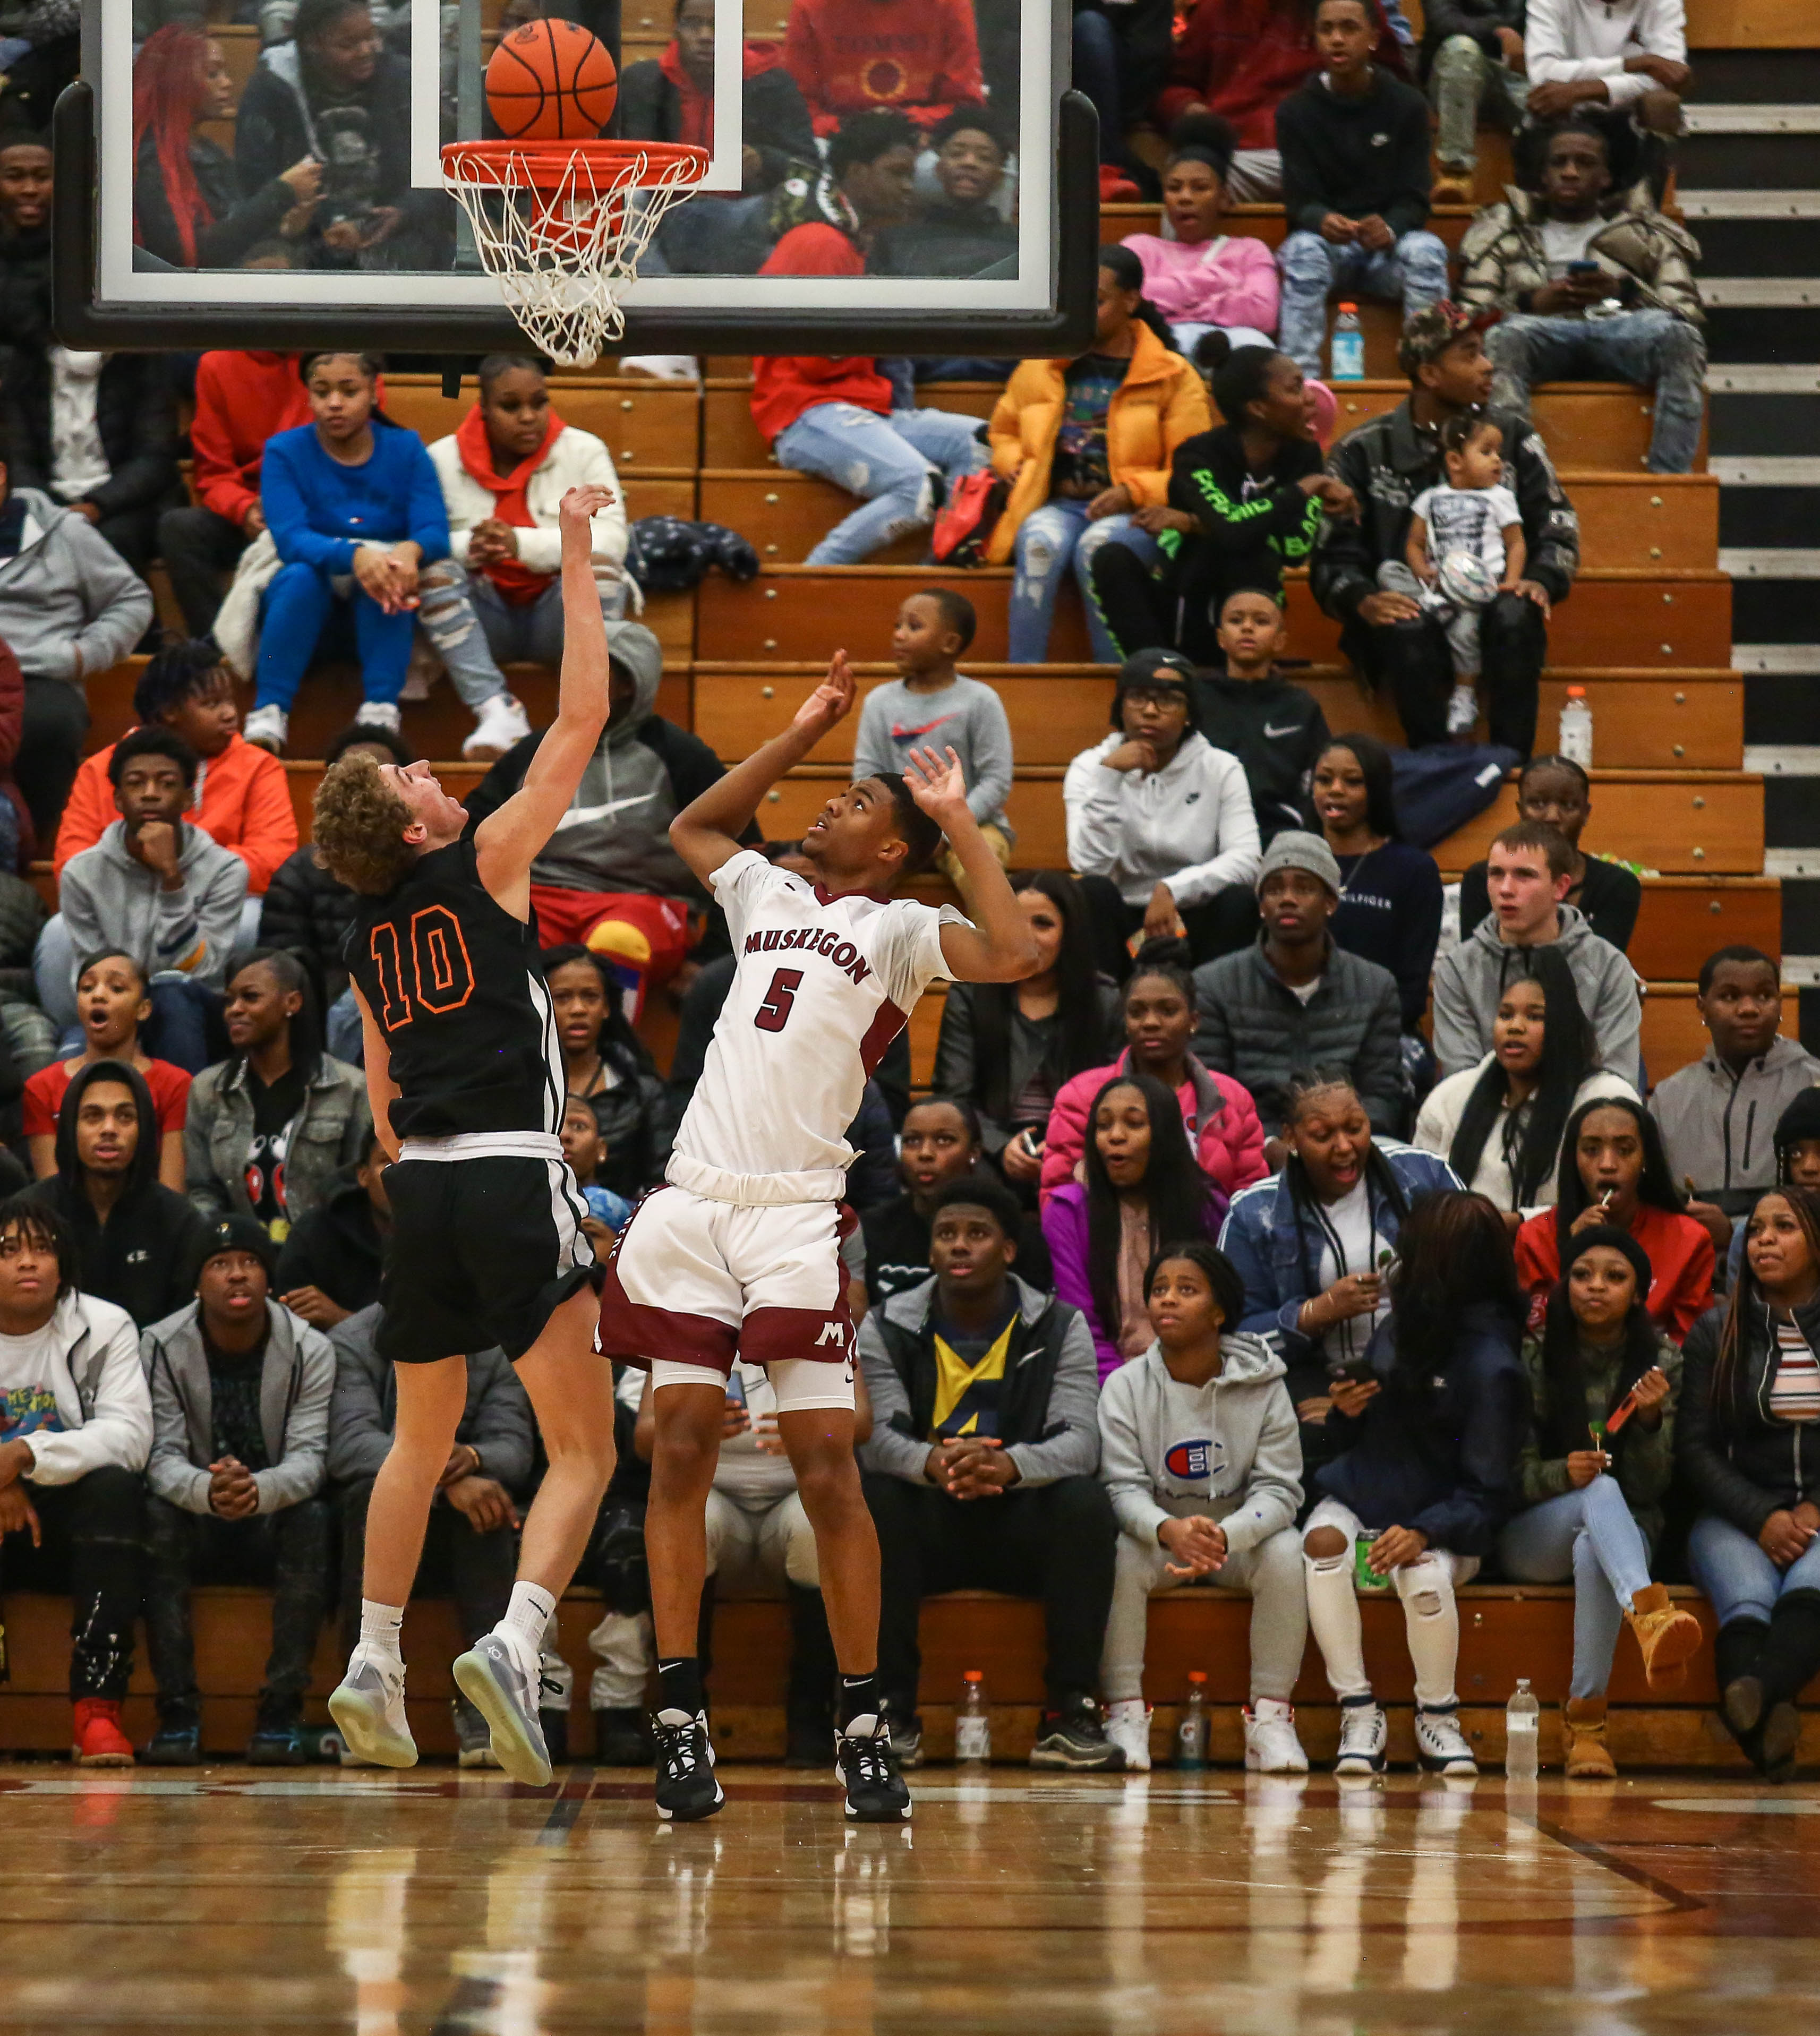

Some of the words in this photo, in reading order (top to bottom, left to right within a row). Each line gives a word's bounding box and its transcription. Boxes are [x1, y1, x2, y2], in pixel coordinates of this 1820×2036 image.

[370, 904, 476, 1032] 10
[743, 928, 872, 986] MUSKEGON
[754, 967, 805, 1033] 5
[814, 1321, 844, 1347] M
